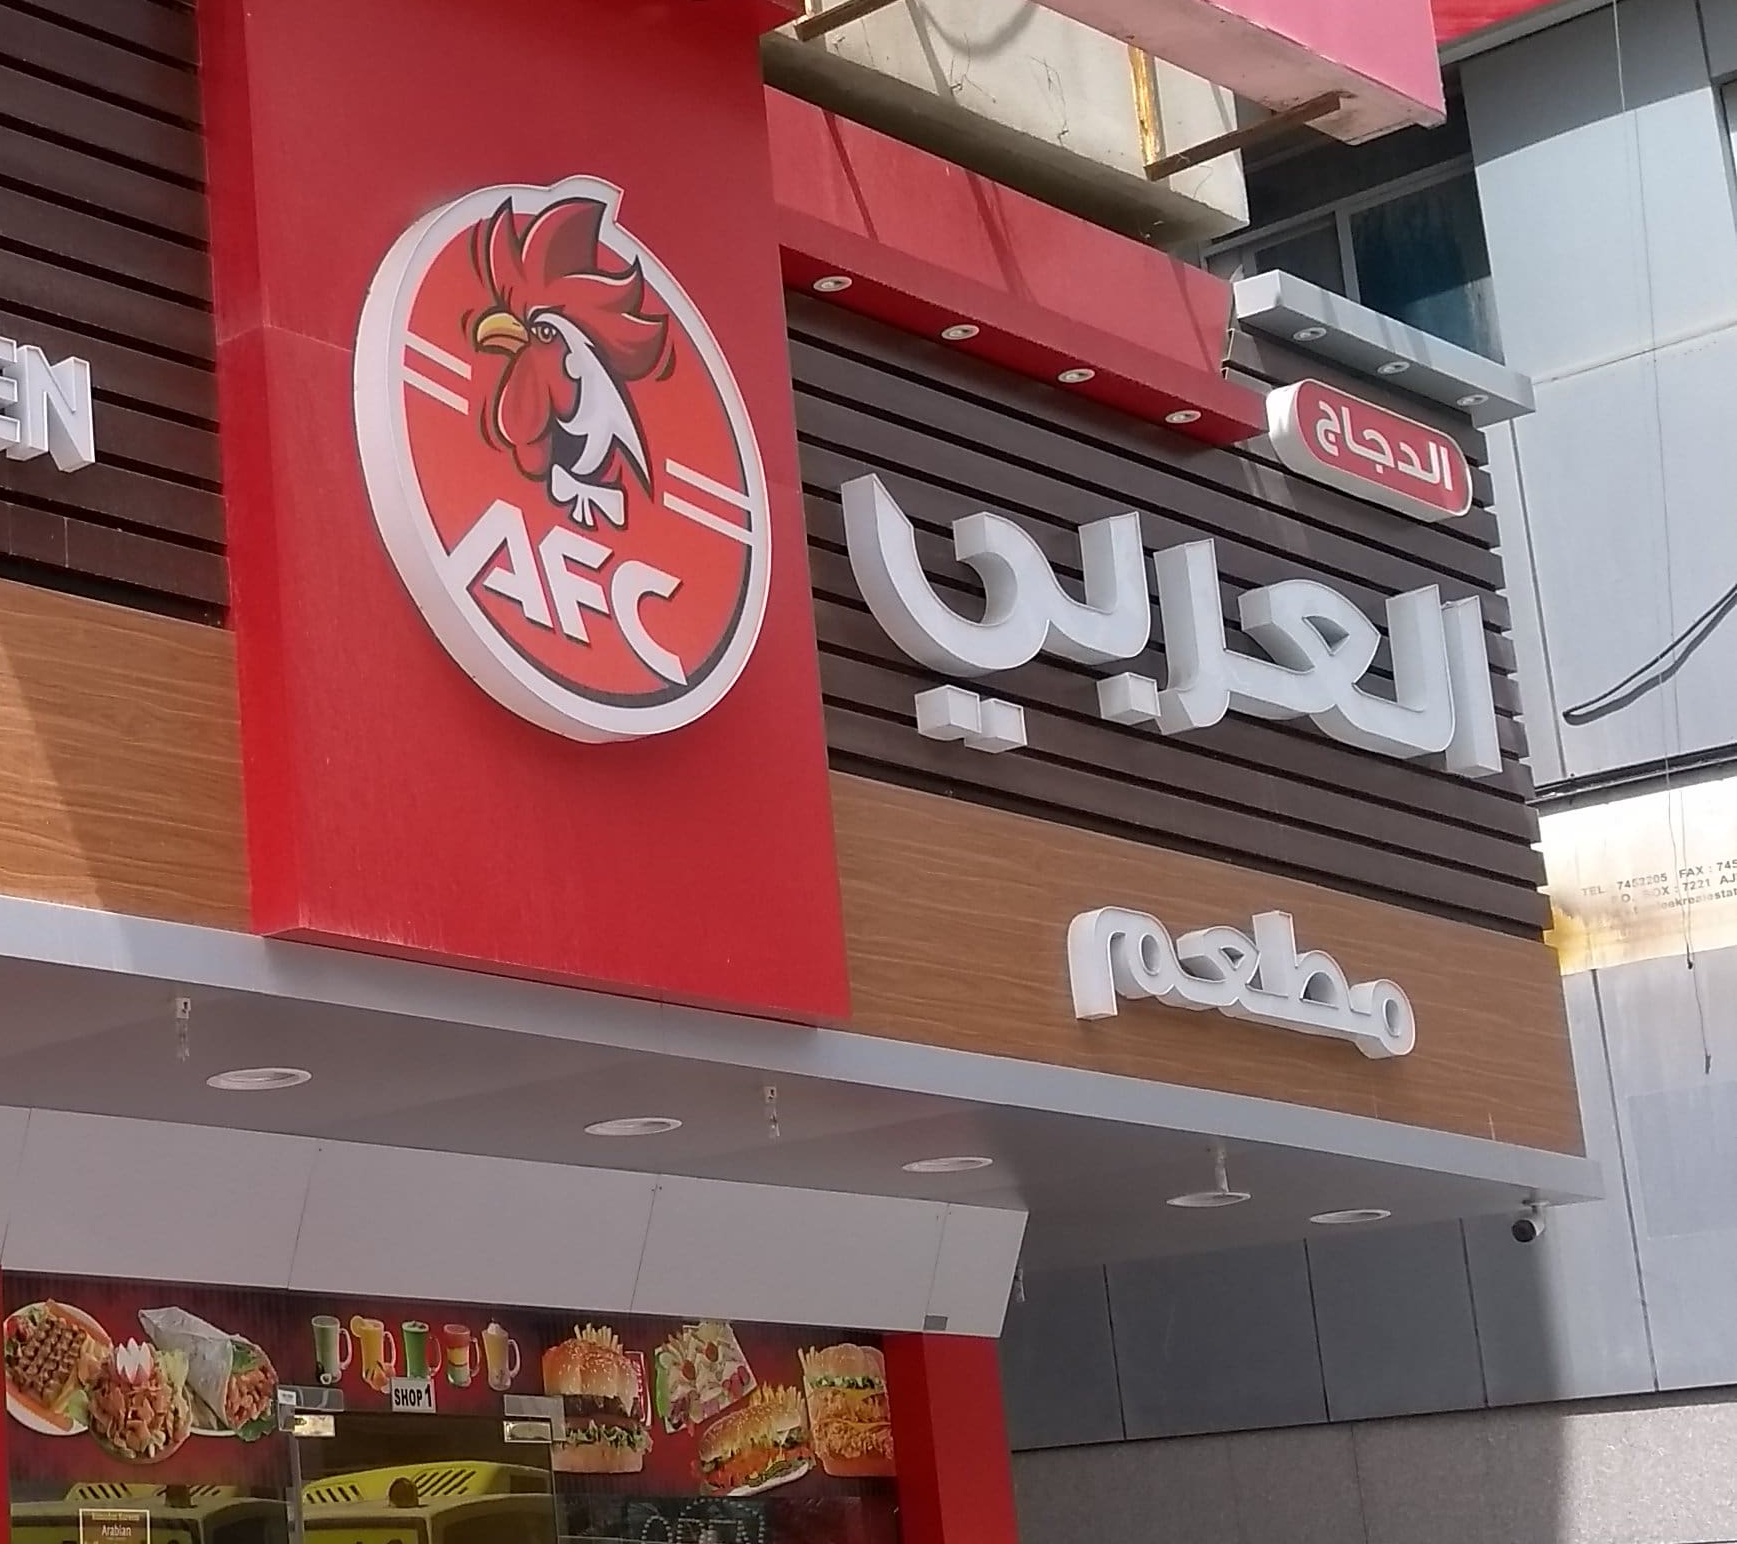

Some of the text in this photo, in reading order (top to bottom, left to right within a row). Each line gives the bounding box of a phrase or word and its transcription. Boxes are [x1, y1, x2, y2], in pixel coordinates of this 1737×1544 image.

[1315, 399, 1453, 491] الدجاج
[447, 498, 687, 685] AFC
[841, 473, 1503, 777] العربي
[1679, 866, 1704, 880] FAX
[1067, 905, 1416, 1059] مطعم
[394, 1384, 432, 1408] SHOP 1
